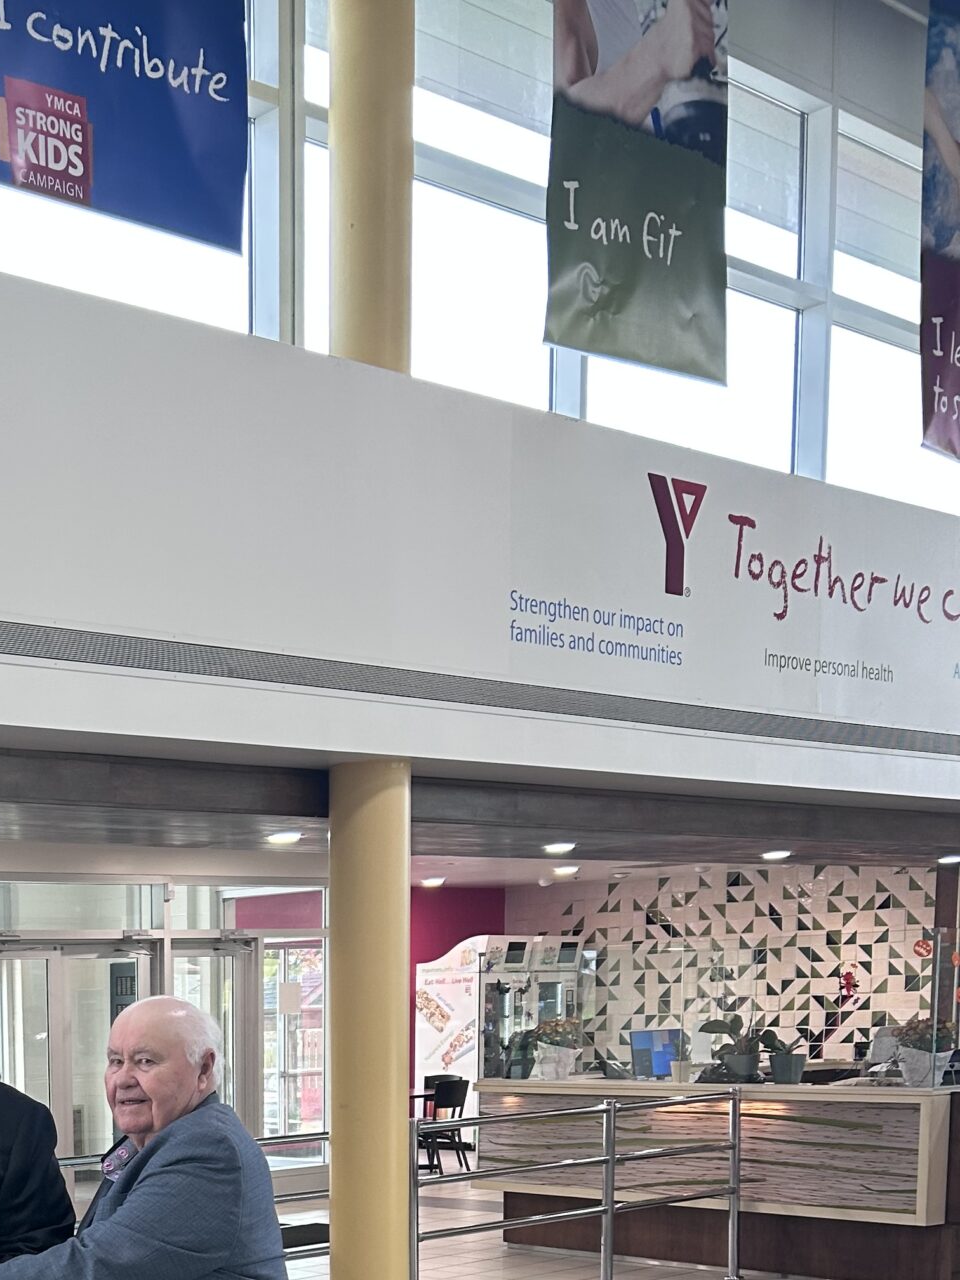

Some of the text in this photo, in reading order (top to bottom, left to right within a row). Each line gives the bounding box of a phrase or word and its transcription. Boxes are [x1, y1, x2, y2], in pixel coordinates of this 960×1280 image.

[15, 106, 83, 143] STRONG
[45, 93, 81, 118] YMCA
[16, 128, 84, 177] KIDS
[20, 168, 84, 199] CAMPAIGN
[563, 180, 683, 267] I am fit
[931, 316, 944, 357] I
[727, 513, 888, 622] Together
[893, 573, 933, 625] we
[509, 589, 684, 638] Strengthen our impact on
[509, 619, 683, 667] families and communities
[764, 647, 893, 683] Improve personal health
